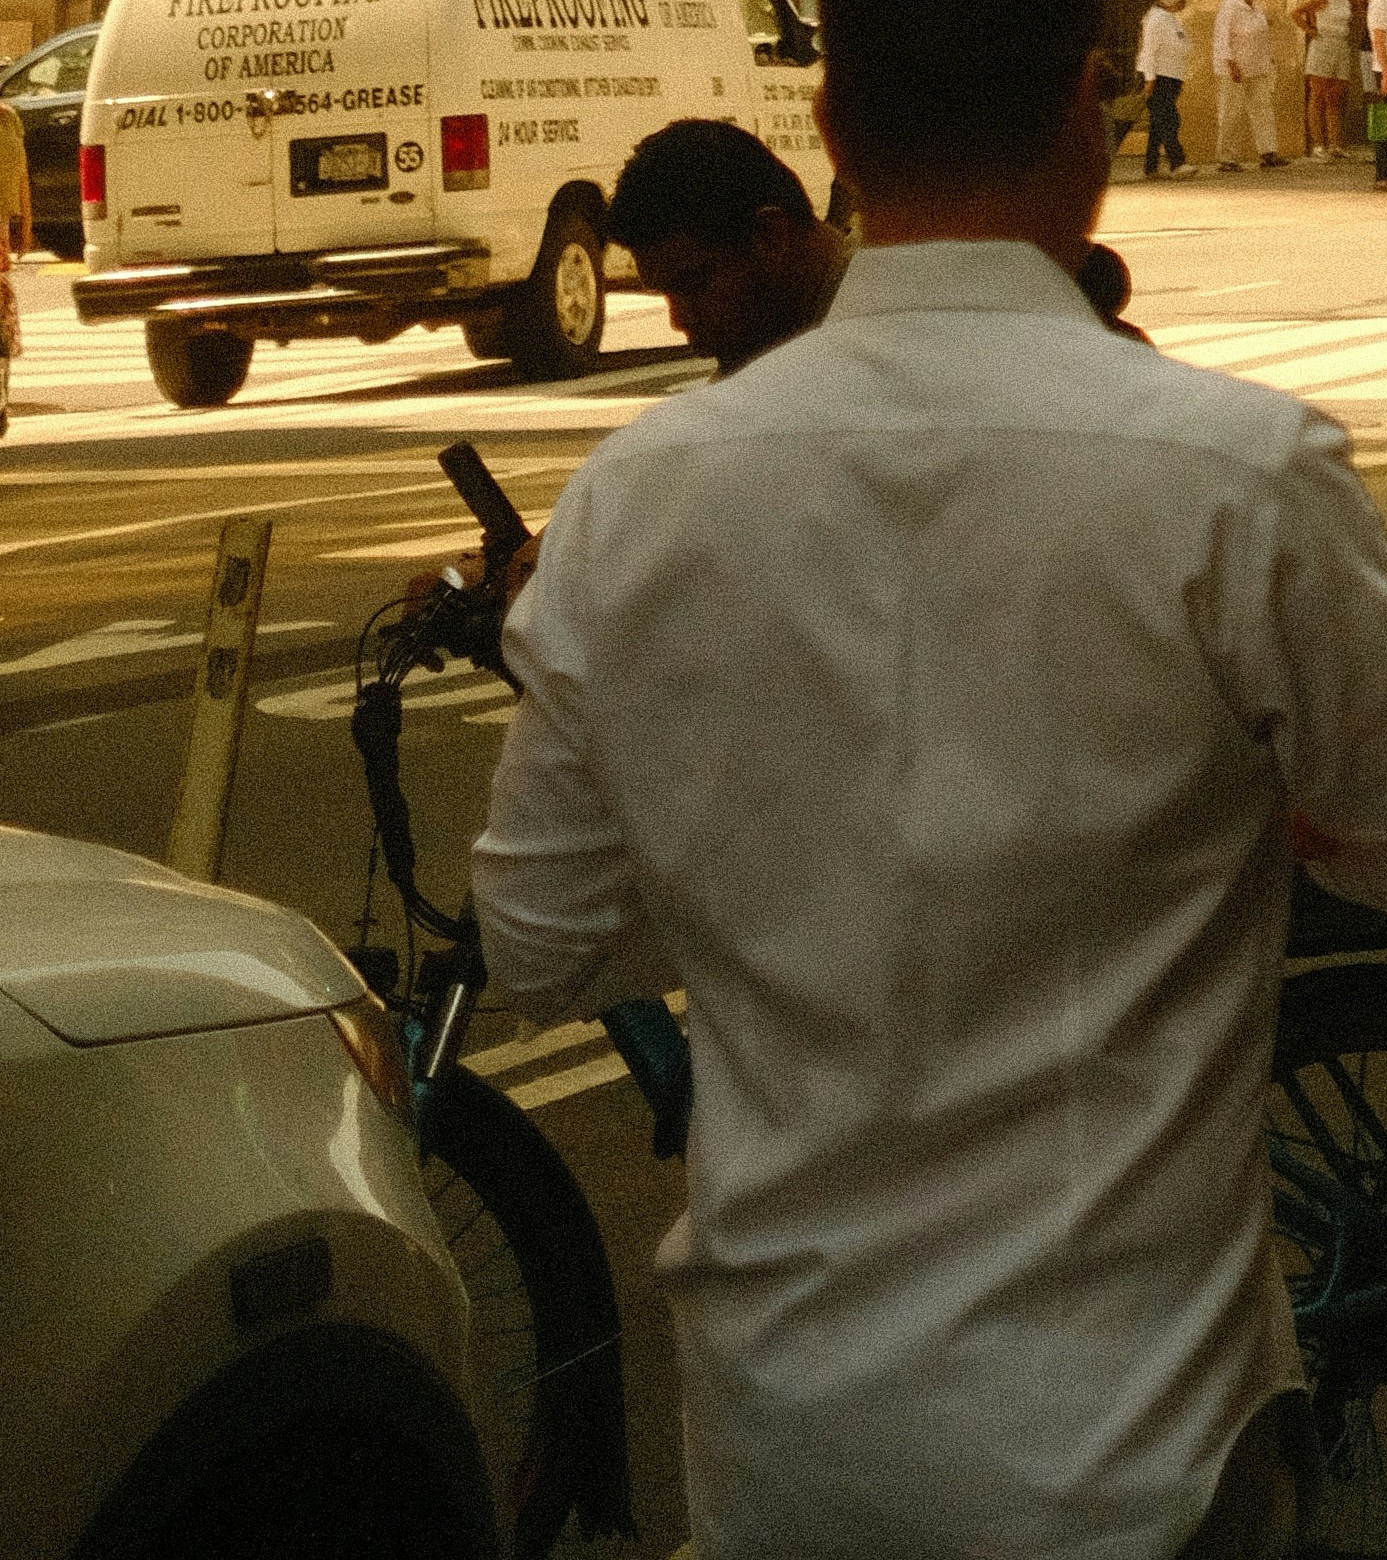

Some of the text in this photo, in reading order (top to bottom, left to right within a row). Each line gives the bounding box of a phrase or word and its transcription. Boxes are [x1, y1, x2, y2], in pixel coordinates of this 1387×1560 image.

[197, 17, 351, 51] CORPORATION
[204, 50, 335, 81] OF AMERICA
[119, 105, 168, 131] DIAL
